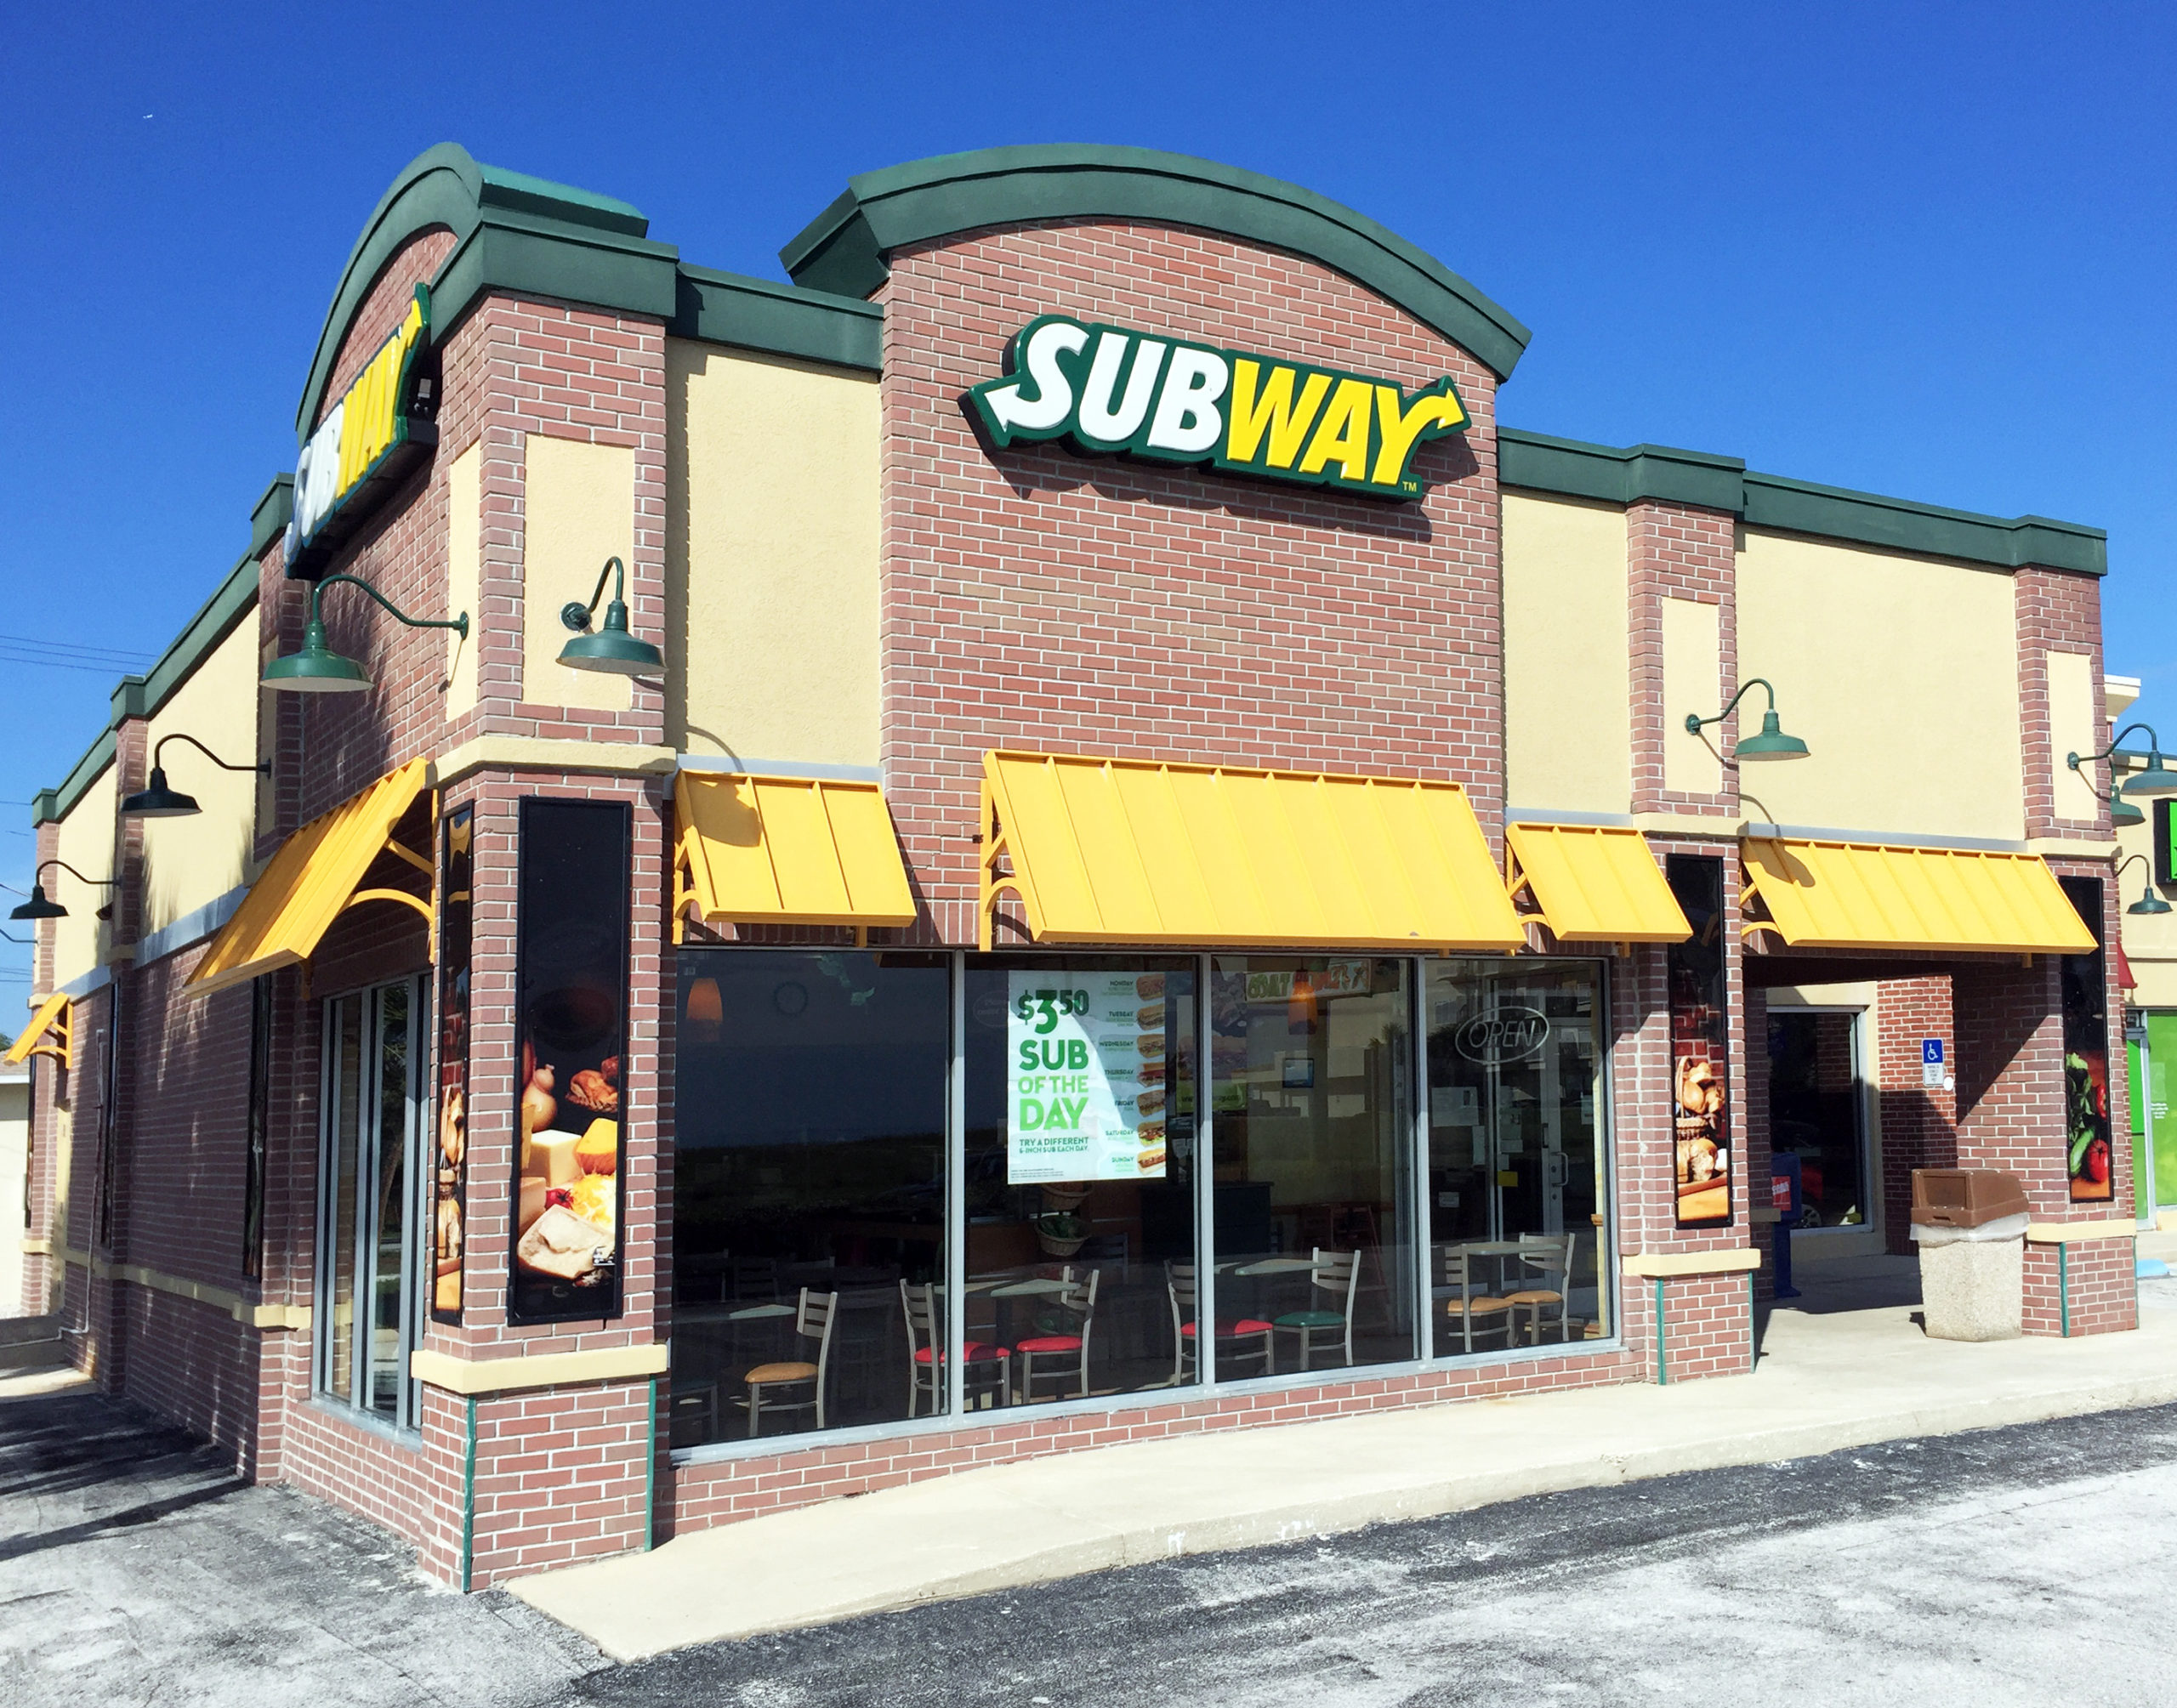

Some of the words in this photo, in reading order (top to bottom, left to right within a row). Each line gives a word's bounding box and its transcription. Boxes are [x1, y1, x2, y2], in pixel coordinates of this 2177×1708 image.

[985, 323, 1464, 485] SUBWAY
[1402, 481, 1418, 492] TM
[1469, 1020, 1536, 1048] OPEN
[1020, 1039, 1088, 1070] SUB
[1018, 1075, 1045, 1094] OF
[1049, 1075, 1088, 1093] THE
[1020, 1098, 1088, 1131] DAY
[1044, 1137, 1088, 1145] DIFFERENT
